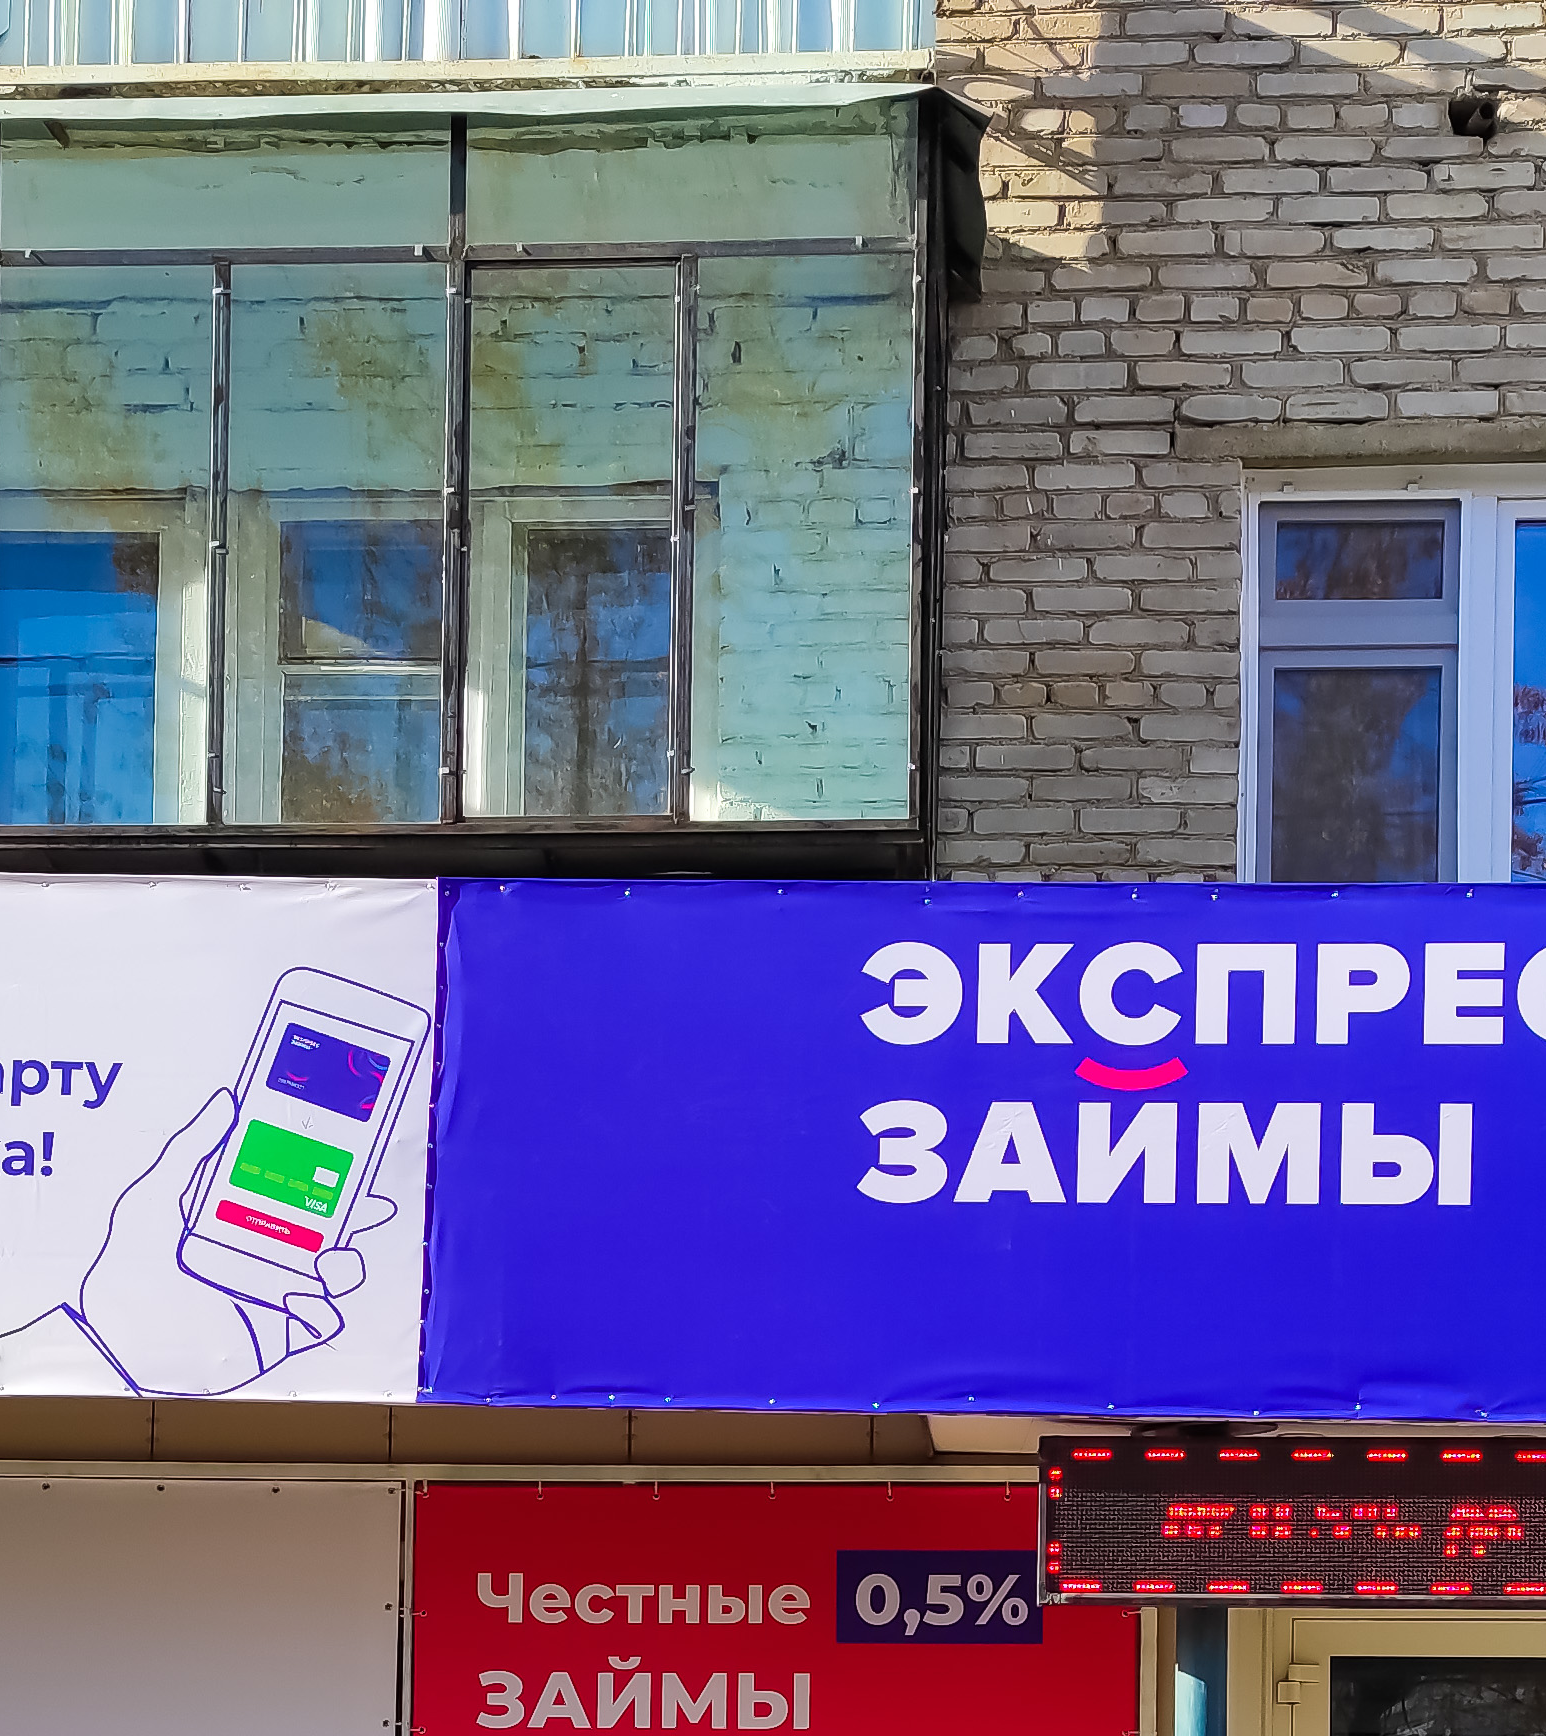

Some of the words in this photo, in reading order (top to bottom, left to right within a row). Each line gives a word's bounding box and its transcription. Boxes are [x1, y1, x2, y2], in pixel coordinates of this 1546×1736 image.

[857, 1056, 1474, 1205] ЗАЙМЫ
[304, 1196, 329, 1213] VISA
[476, 1572, 811, 1625] Честные
[855, 1573, 1029, 1636] 0,5%
[476, 1656, 812, 1730] ЗАЙМЫ
